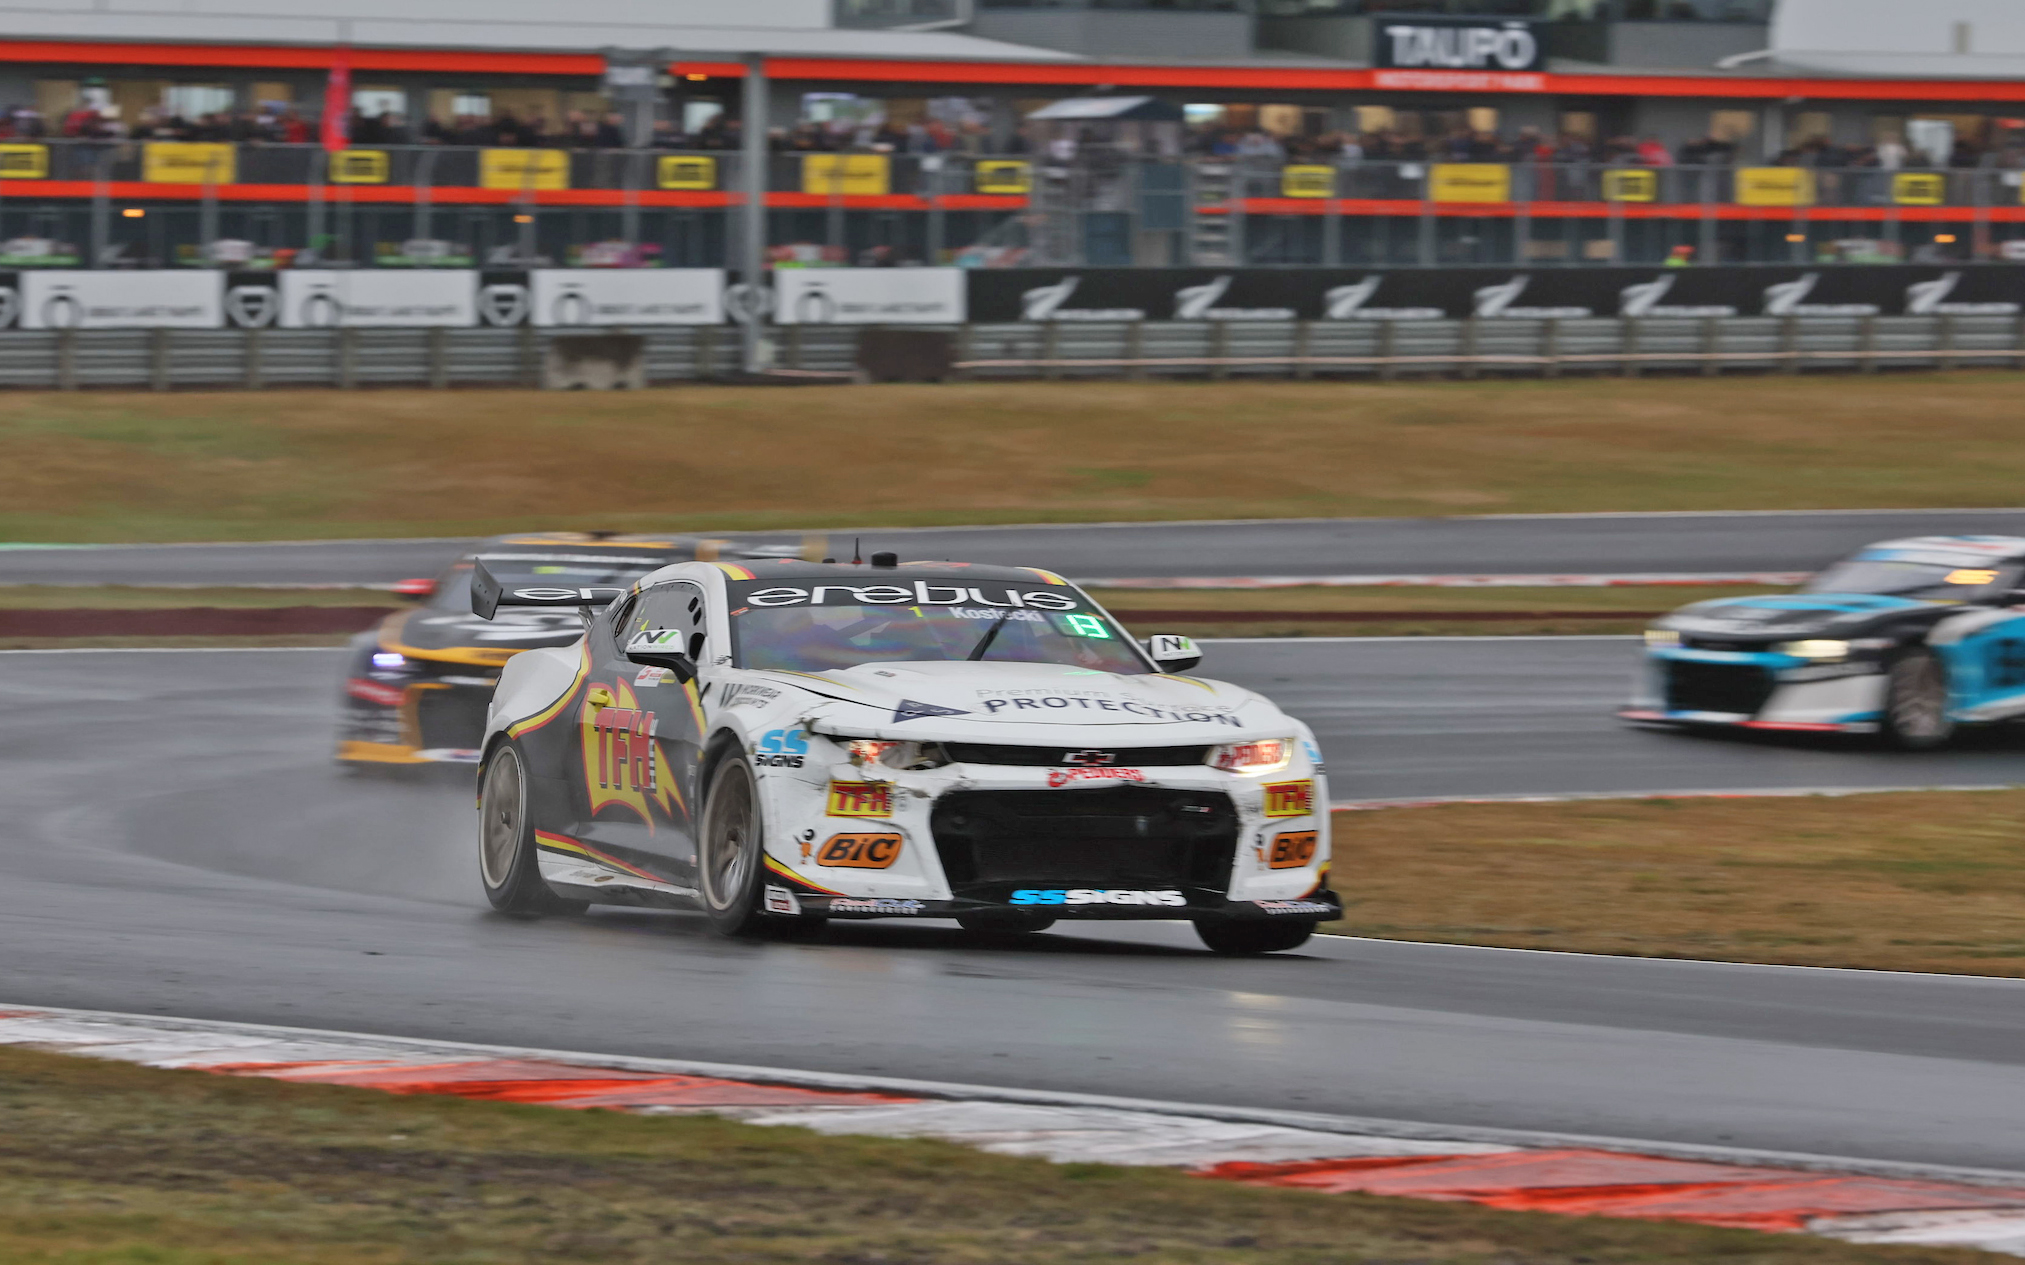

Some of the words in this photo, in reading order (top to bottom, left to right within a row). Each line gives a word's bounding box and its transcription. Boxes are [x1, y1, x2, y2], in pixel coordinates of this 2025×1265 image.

[1385, 21, 1536, 69] TAUPŌ
[747, 580, 1077, 611] erebus
[982, 696, 1243, 729] PROTECTION
[594, 706, 656, 794] TFH
[834, 784, 893, 813] TFH
